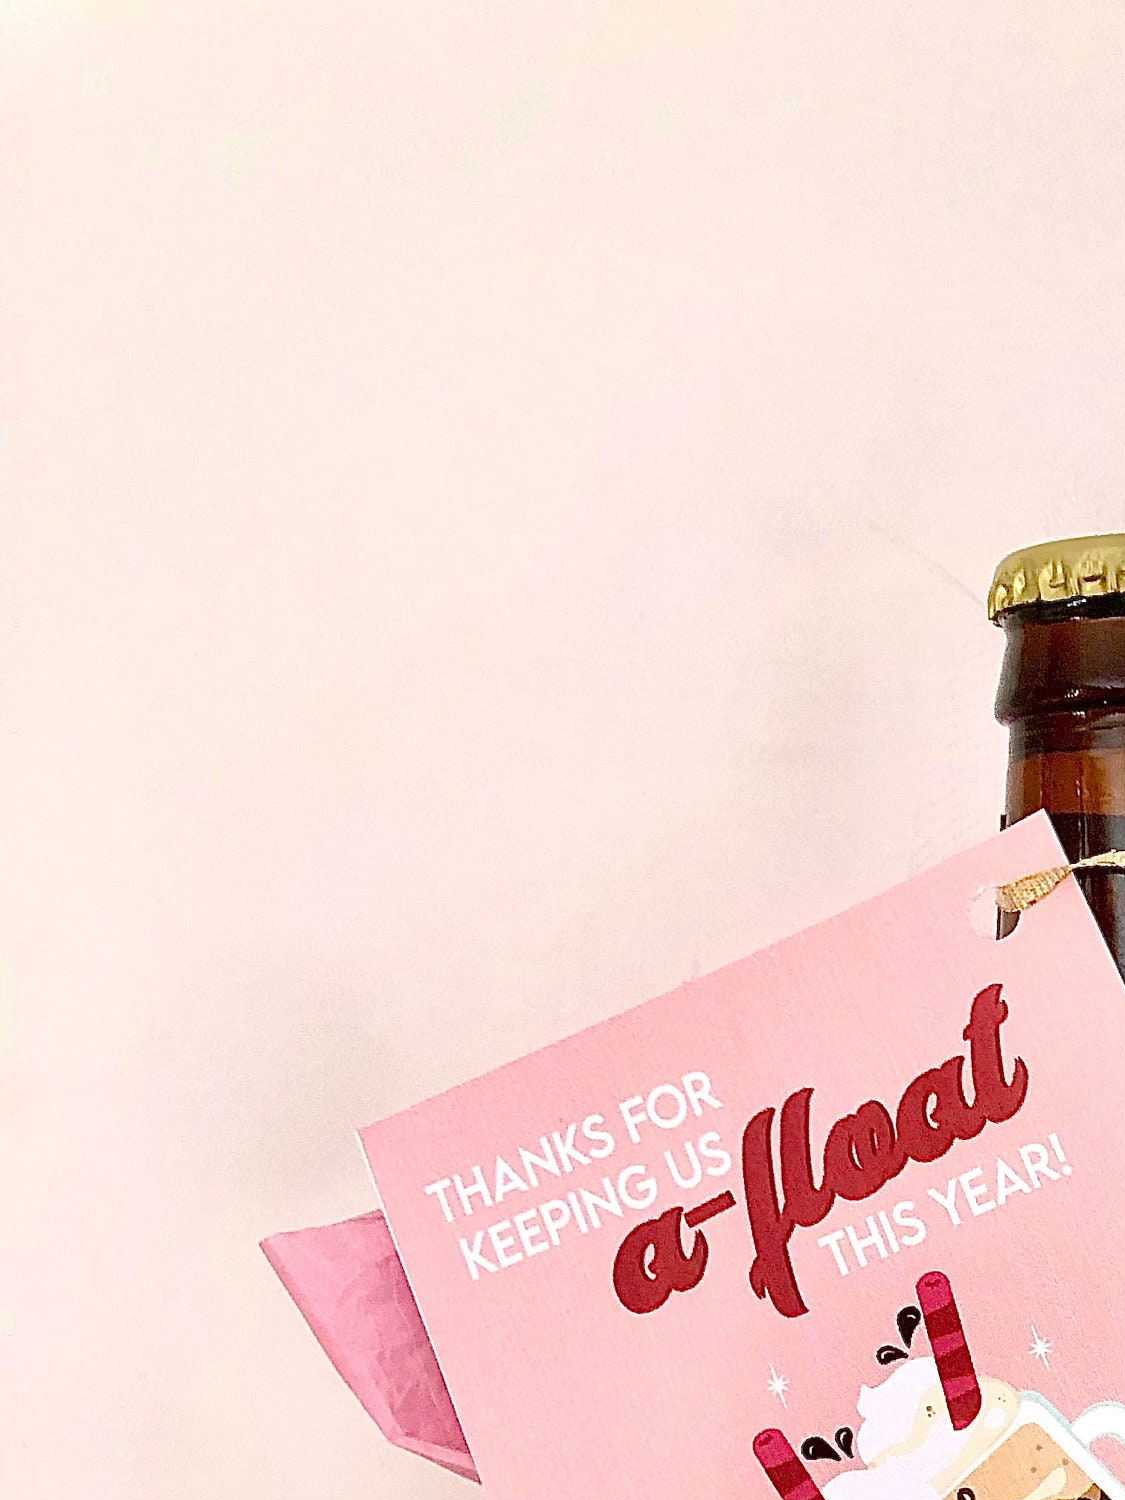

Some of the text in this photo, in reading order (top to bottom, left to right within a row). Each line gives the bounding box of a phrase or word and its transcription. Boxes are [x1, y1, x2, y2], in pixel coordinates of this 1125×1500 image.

[424, 1071, 724, 1224] THANKS FOR
[458, 1131, 733, 1281] KEEPING US
[612, 983, 1030, 1319] a-float
[817, 1132, 1074, 1278] THIS YEAR!
